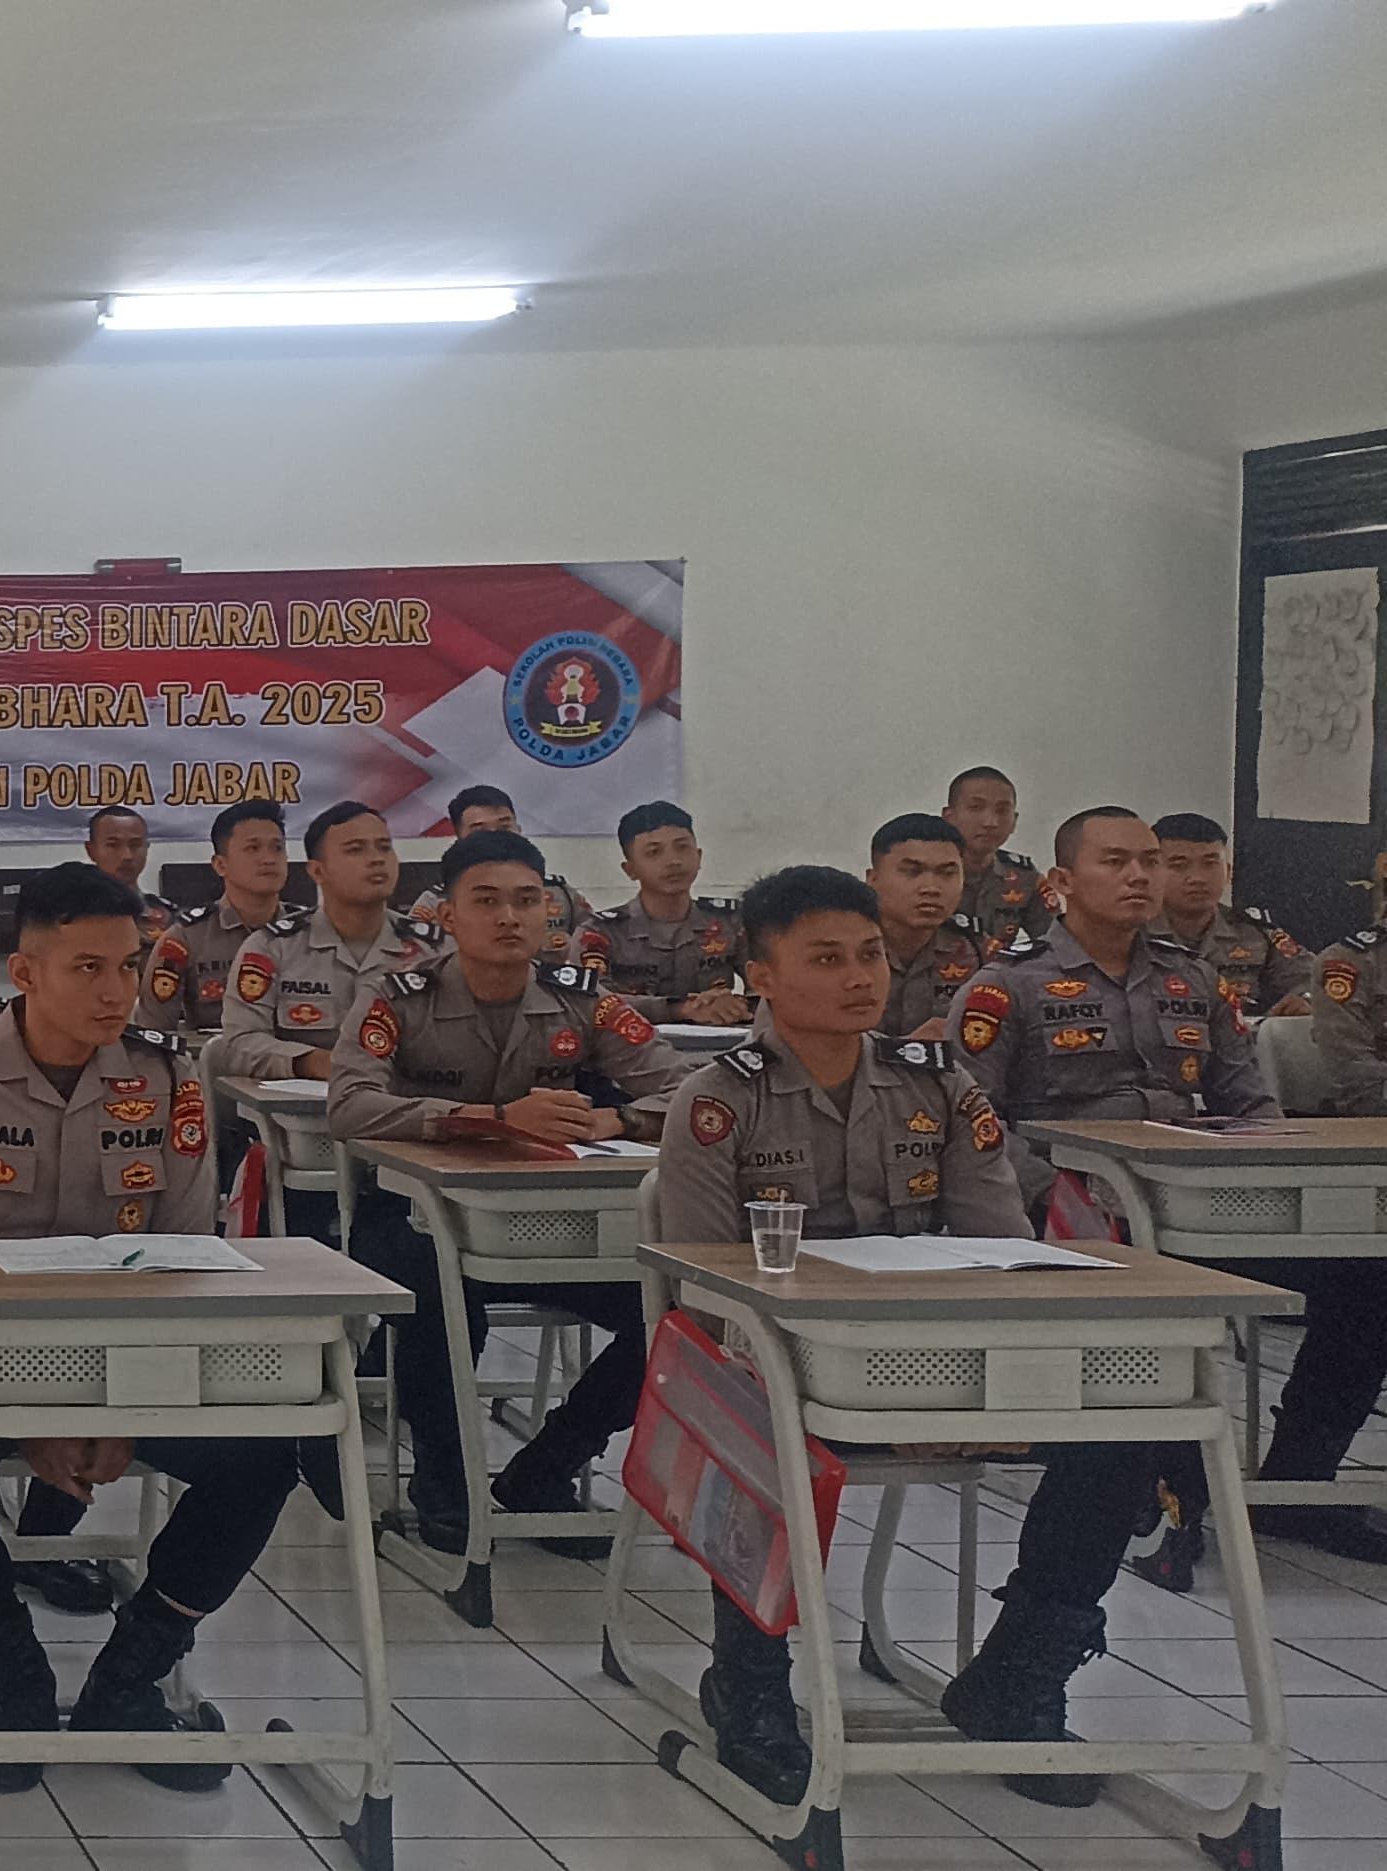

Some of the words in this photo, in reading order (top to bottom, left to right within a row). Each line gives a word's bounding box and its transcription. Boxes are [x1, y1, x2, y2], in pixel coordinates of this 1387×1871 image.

[100, 602, 278, 650] BINTARA
[288, 599, 430, 647] DASAR
[160, 682, 247, 728] T.A.
[261, 680, 384, 725] 2025
[513, 717, 564, 761] POLDA
[577, 715, 632, 761] JABAR
[23, 763, 153, 808] POLDA
[164, 761, 301, 805] JABAR
[280, 981, 332, 995] FAISAL
[101, 1128, 164, 1150] POLRI
